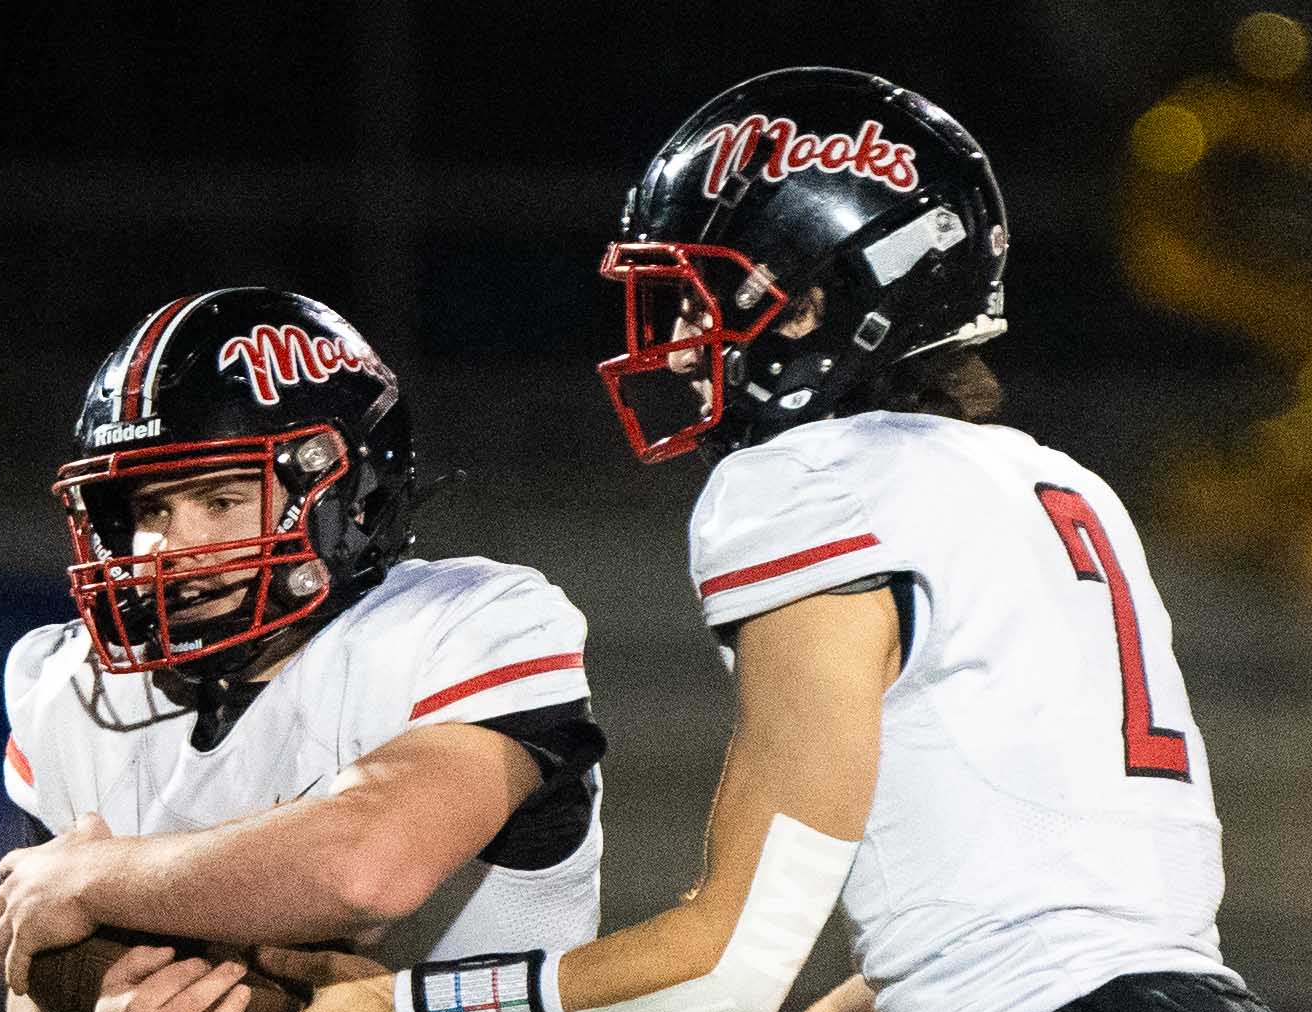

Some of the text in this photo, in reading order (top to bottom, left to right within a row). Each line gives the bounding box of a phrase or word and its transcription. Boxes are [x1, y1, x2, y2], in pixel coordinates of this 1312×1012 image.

[696, 113, 920, 199] Mooks
[94, 418, 162, 448] Riddell
[1035, 481, 1193, 784] 2
